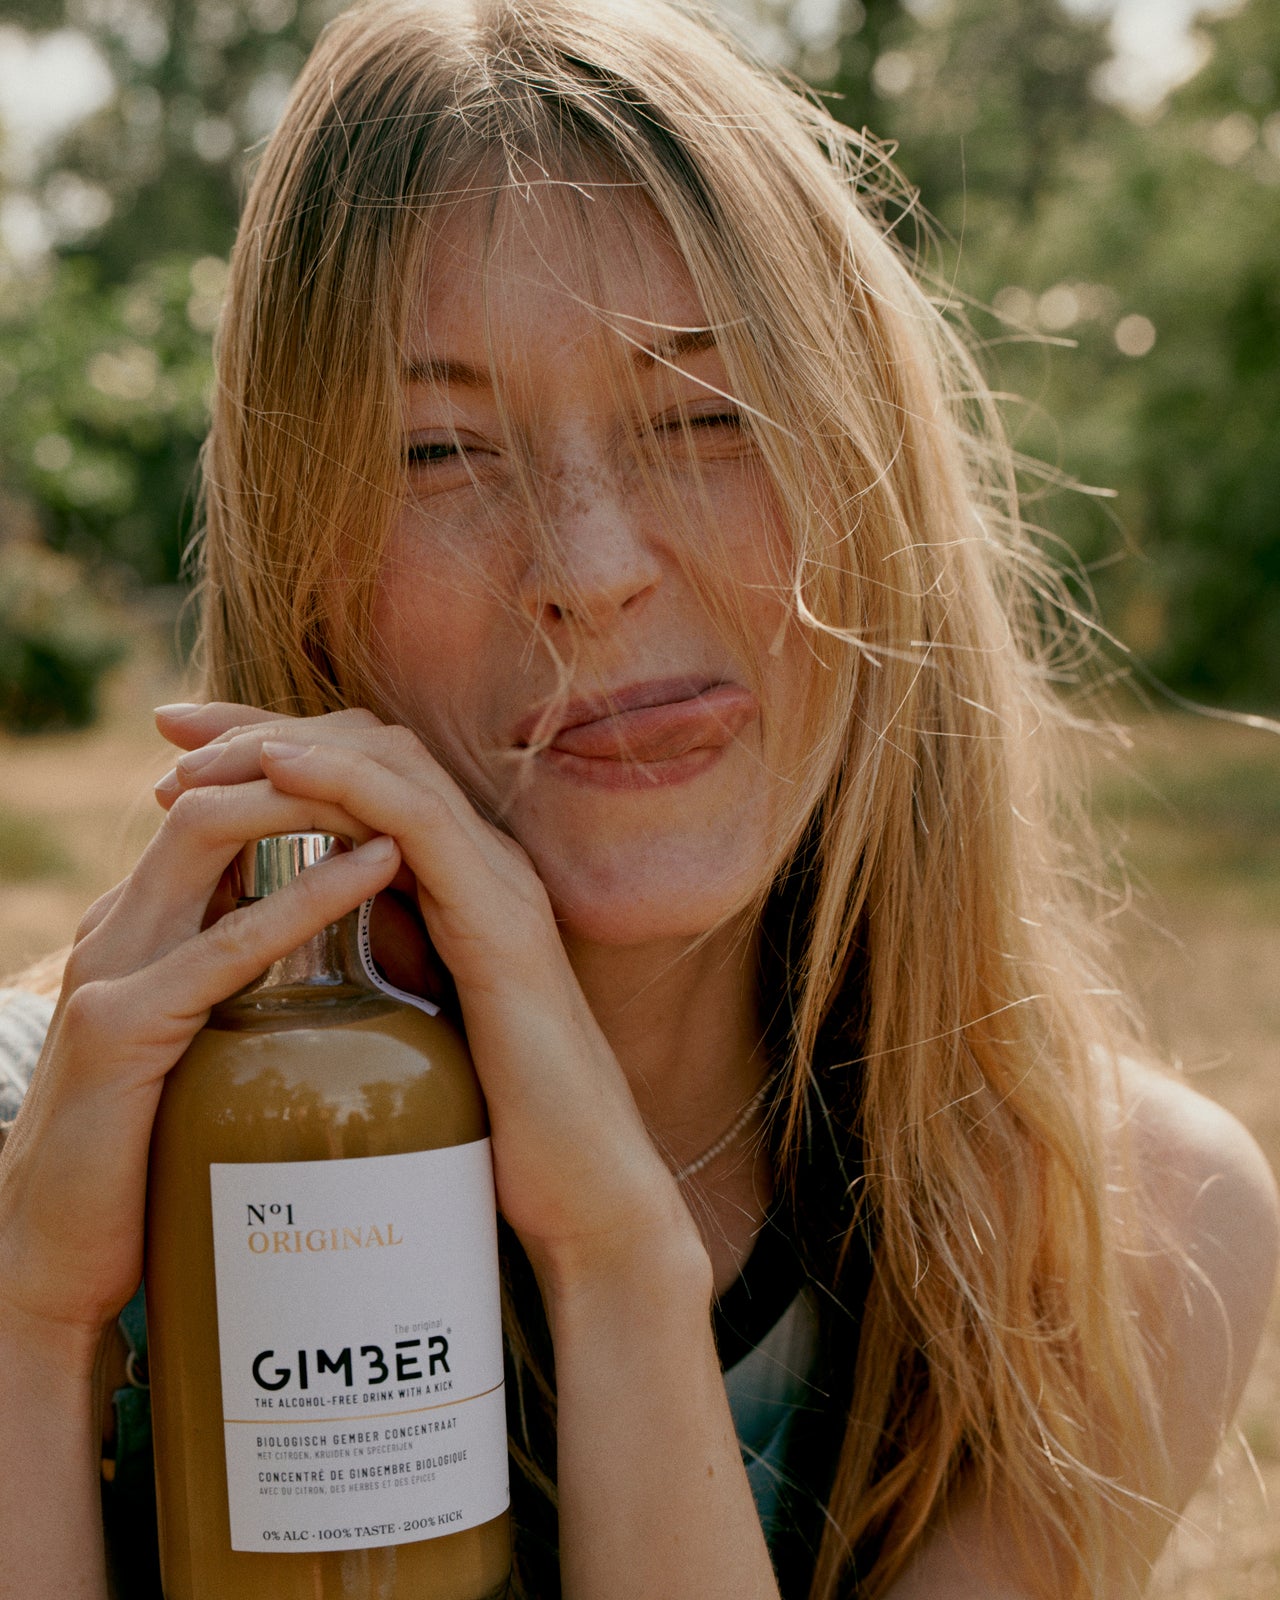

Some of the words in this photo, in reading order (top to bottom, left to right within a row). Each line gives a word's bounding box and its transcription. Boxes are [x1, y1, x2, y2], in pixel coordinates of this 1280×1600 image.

[247, 1223, 403, 1254] ORIGINAL
[394, 1324, 409, 1335] The
[412, 1318, 443, 1333] original
[255, 1398, 274, 1408] THE
[278, 1394, 359, 1408] ALCOHOL-FREE
[363, 1390, 394, 1404] DRINK
[399, 1385, 422, 1398] WITH
[425, 1384, 431, 1394] A
[434, 1380, 454, 1392] KICK
[256, 1436, 327, 1448] BIOLOGISCH
[333, 1430, 380, 1445] GEMBER
[384, 1417, 458, 1440] CONCENTRAAT
[257, 1452, 272, 1461] MET
[314, 1449, 350, 1460] KRUIDEN
[353, 1448, 364, 1457] EN
[366, 1442, 414, 1455] SPECERIJEN
[258, 1468, 325, 1483] CONCENTRÉ
[330, 1470, 345, 1481] DE
[349, 1462, 412, 1480] GINGEMBRE
[416, 1450, 468, 1471] BIOLOGIQUE
[259, 1487, 279, 1496] AVEC
[281, 1486, 293, 1496] DU
[330, 1485, 346, 1495] DES
[349, 1480, 380, 1493] HERBES
[382, 1479, 392, 1489] ET
[394, 1477, 409, 1488] DES
[262, 1530, 281, 1542] 0%
[283, 1529, 309, 1542] ALC
[318, 1526, 352, 1541] 100%
[355, 1523, 396, 1538] TASTE
[403, 1515, 436, 1533] 200%
[437, 1508, 464, 1526] KICK
